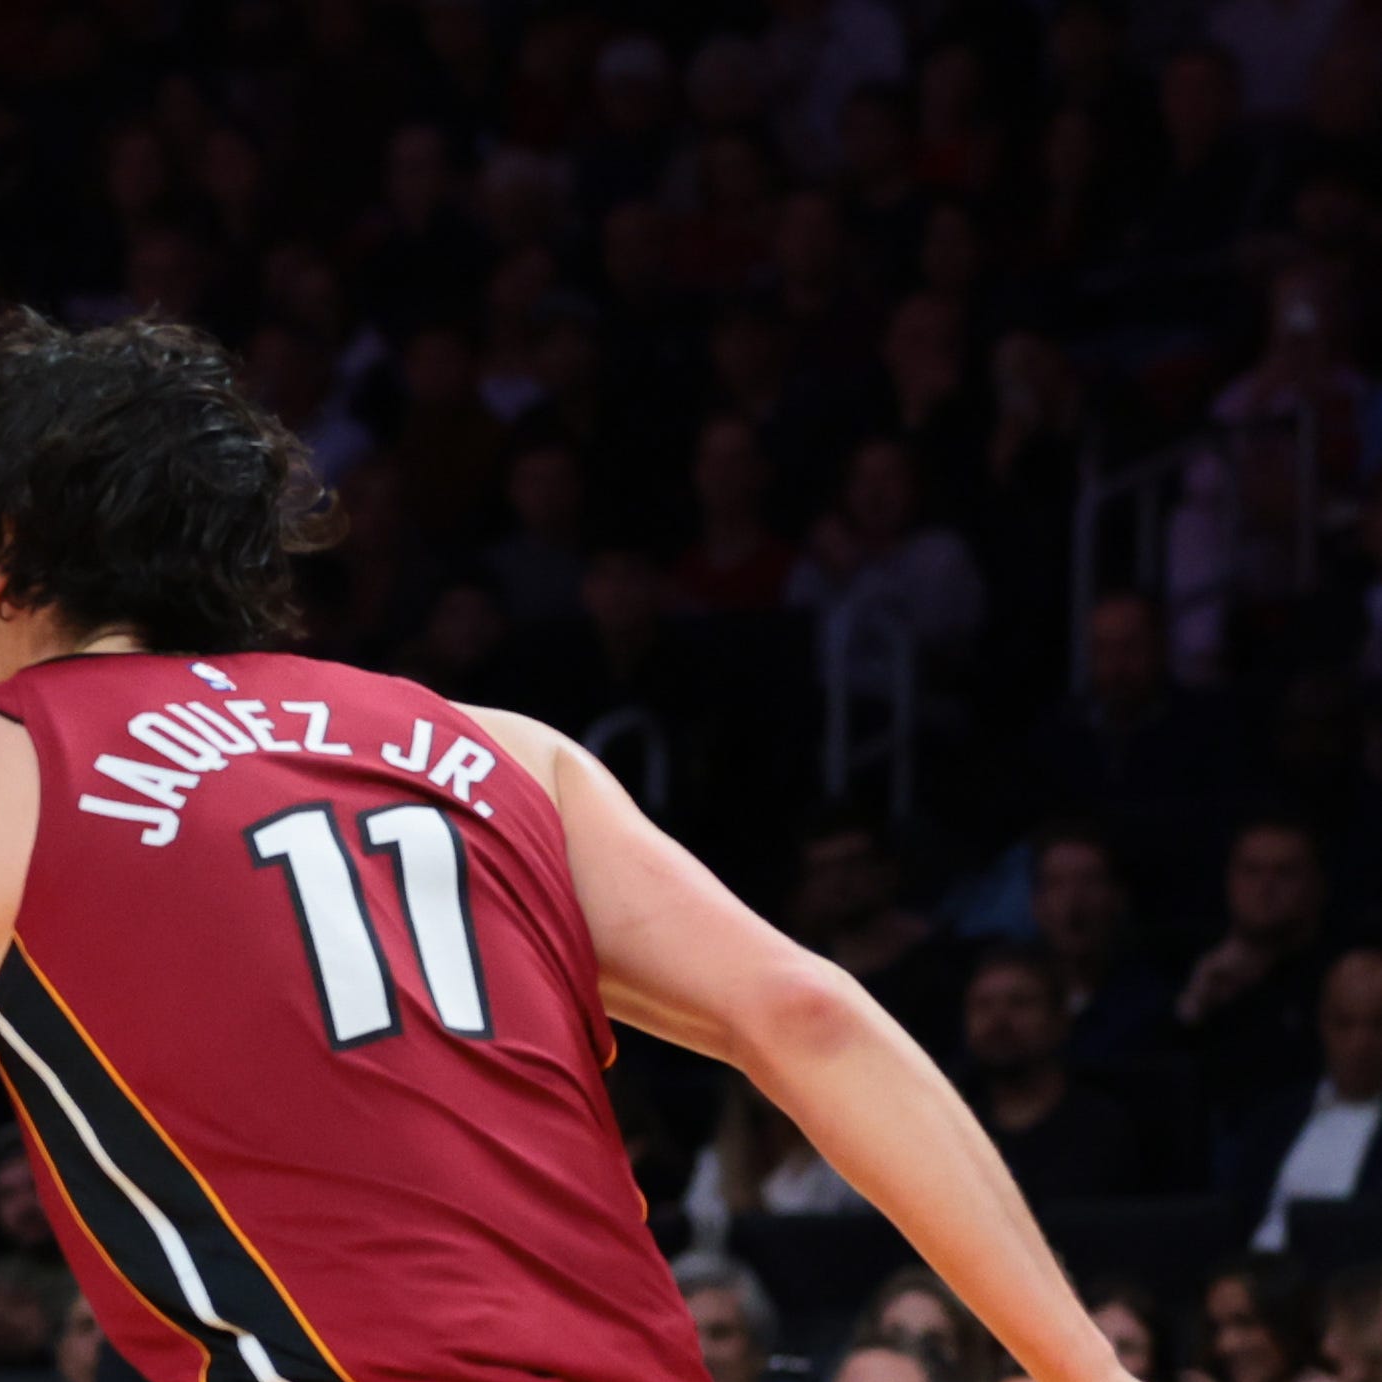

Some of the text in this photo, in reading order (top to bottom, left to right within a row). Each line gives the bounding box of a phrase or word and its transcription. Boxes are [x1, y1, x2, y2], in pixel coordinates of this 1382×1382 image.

[78, 700, 497, 847] JAQUEZ JR.
[243, 801, 495, 1052] 11
